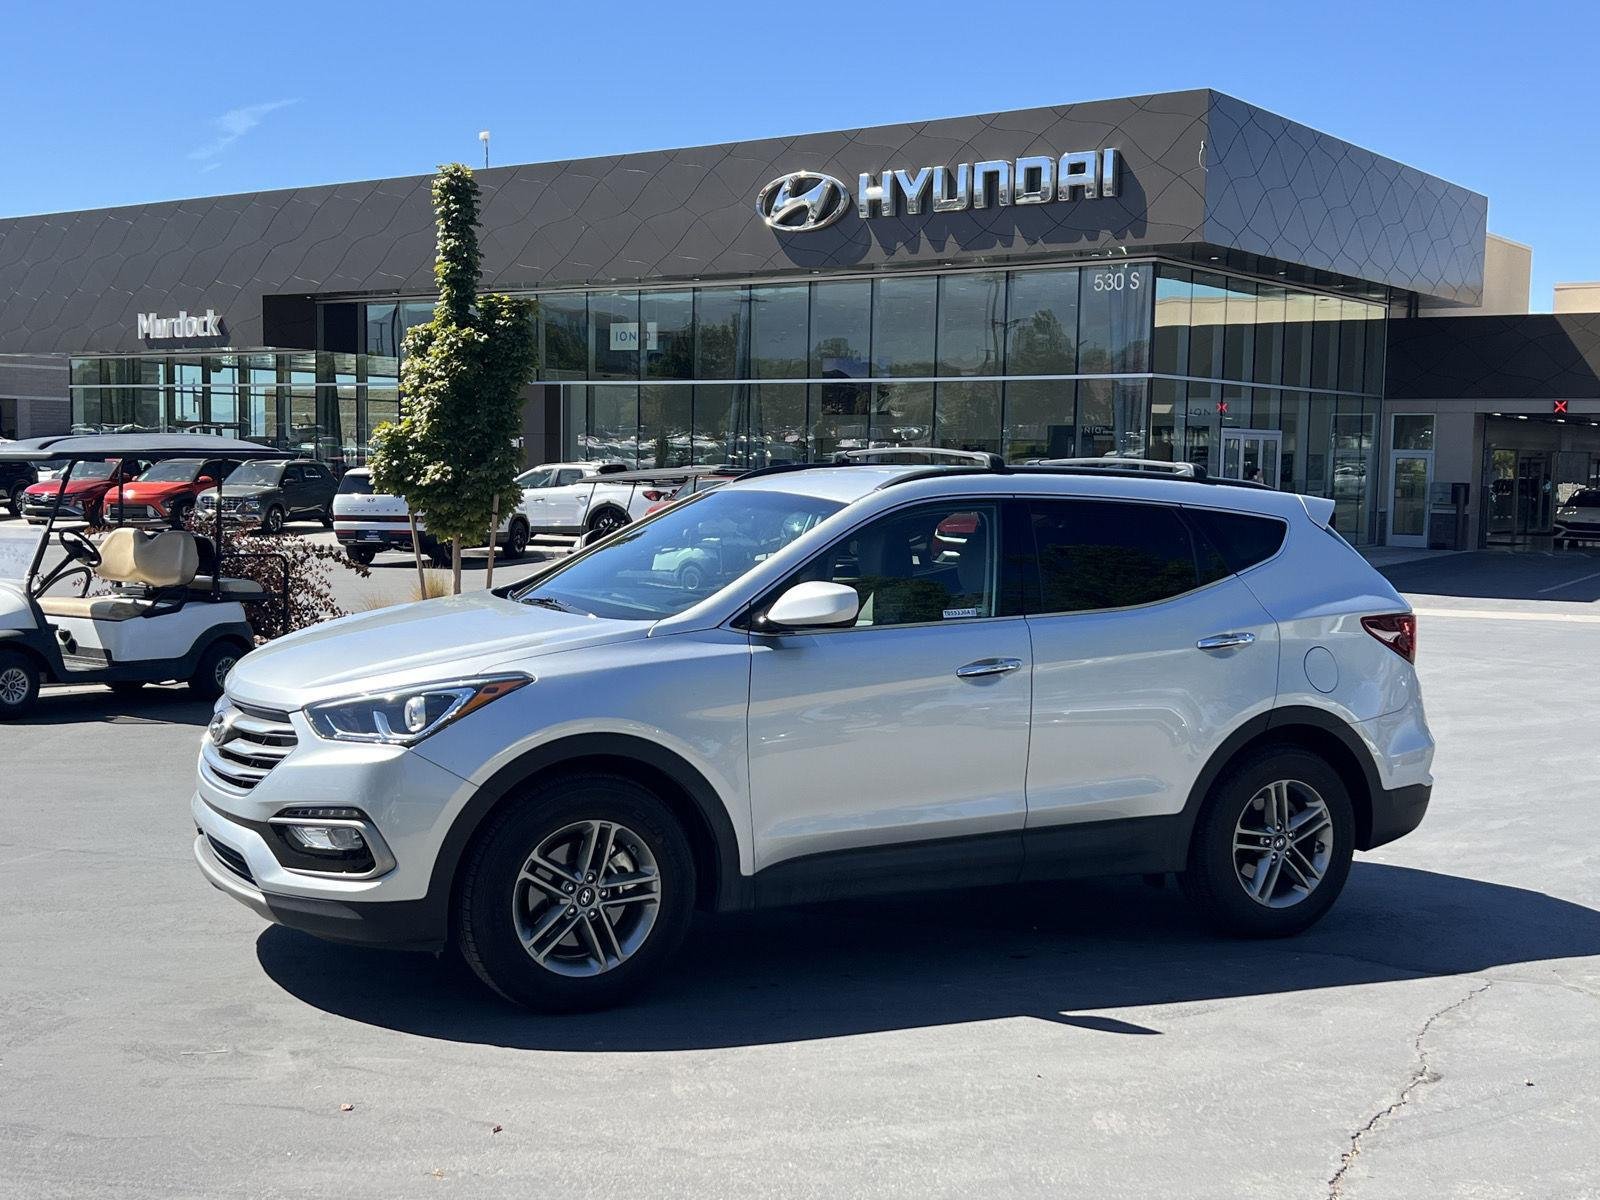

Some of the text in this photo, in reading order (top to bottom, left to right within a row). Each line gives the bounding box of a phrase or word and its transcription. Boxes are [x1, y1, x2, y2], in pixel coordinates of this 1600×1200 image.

[858, 147, 1120, 219] HYUNDAI
[1093, 271, 1140, 291] 530 S
[137, 309, 222, 339] Murdock
